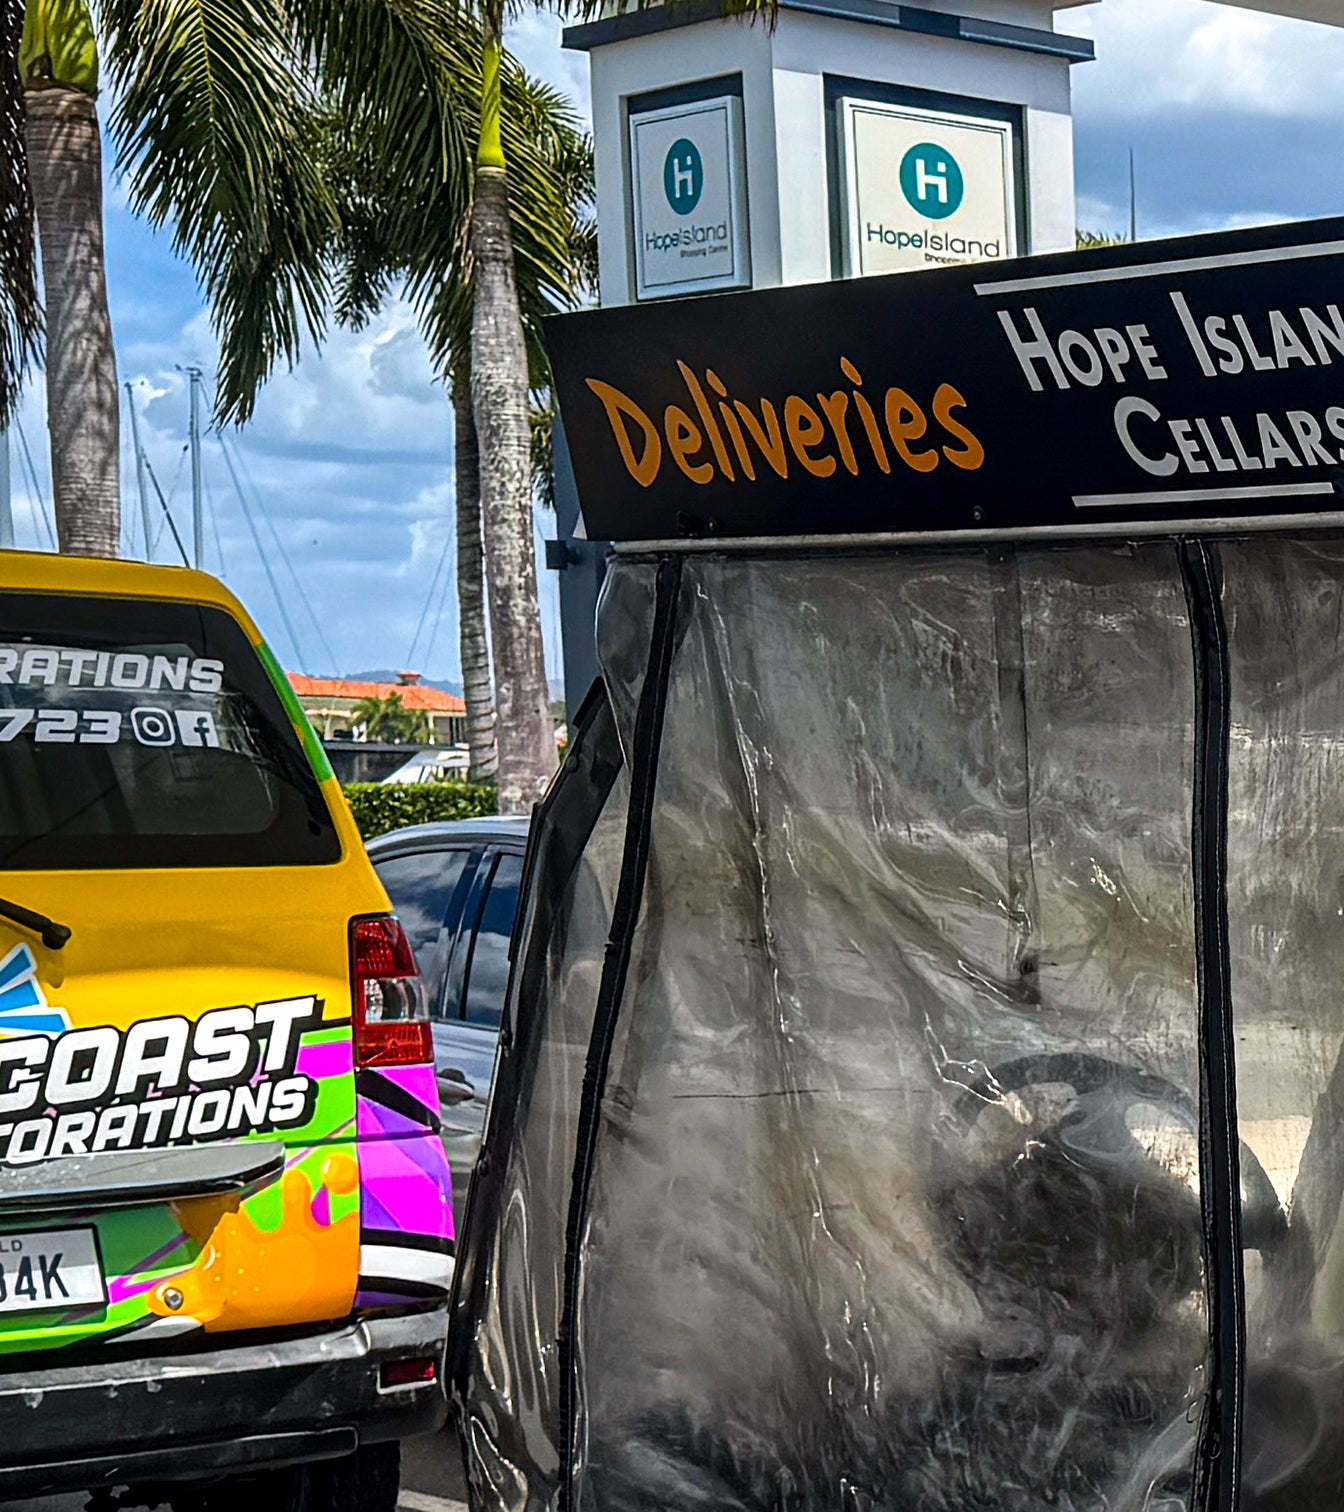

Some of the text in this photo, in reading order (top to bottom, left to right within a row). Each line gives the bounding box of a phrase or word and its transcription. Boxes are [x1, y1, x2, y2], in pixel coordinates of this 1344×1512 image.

[997, 307, 1169, 392] HOPE
[586, 357, 986, 488] Deliveries
[0, 996, 315, 1114] COAST
